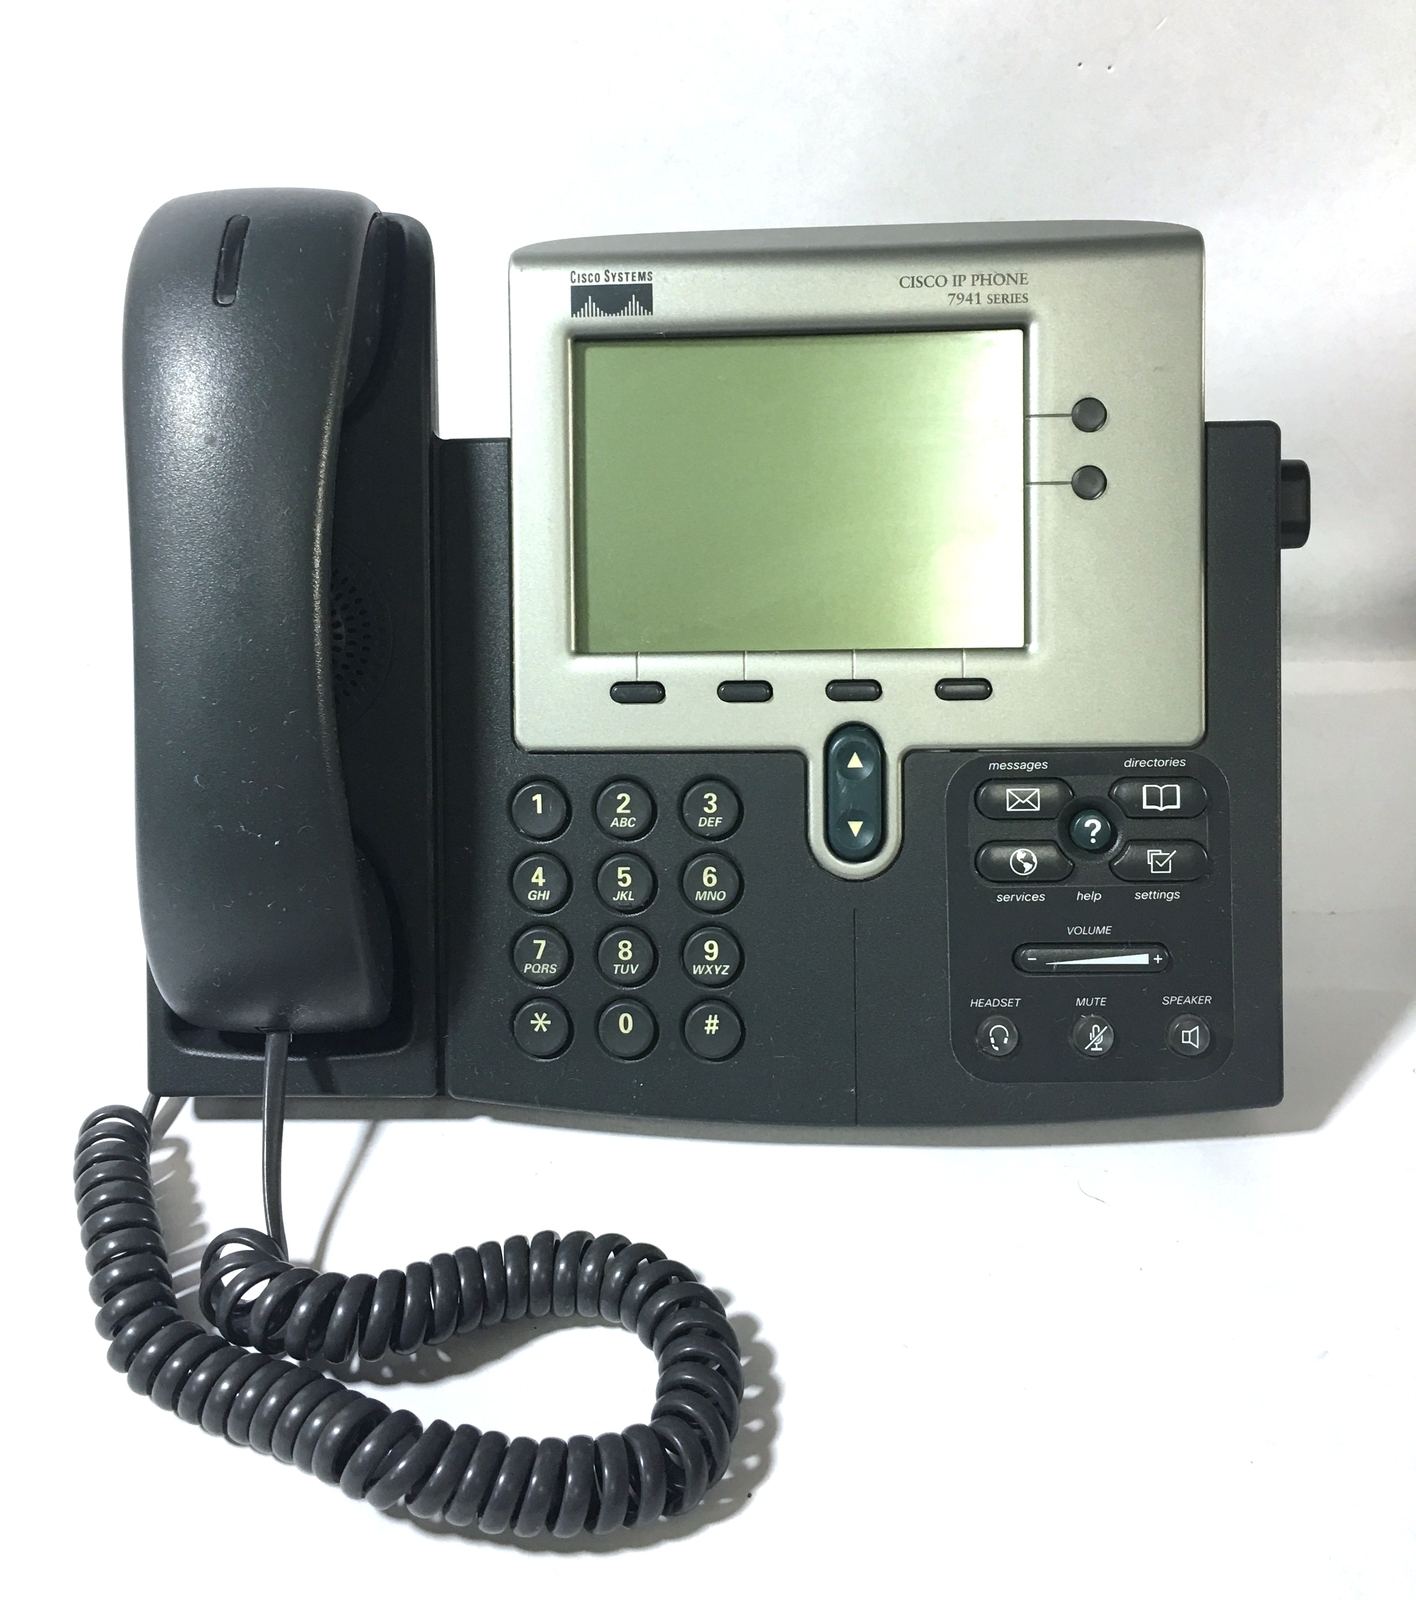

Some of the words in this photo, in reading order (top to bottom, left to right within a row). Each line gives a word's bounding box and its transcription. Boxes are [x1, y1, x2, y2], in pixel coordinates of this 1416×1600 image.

[898, 274, 949, 289] CISCO
[951, 274, 967, 287] IP
[970, 271, 1029, 287] PHONE
[947, 291, 982, 306] 7941
[986, 292, 1029, 305] SERIES
[988, 760, 1049, 772] messages
[1123, 756, 1187, 768] directories
[531, 793, 543, 815] 1
[616, 792, 631, 814] 2
[703, 792, 718, 814] 3
[609, 816, 637, 828] ABC
[697, 816, 723, 828] DEF
[530, 866, 546, 887] 4
[617, 866, 632, 888] 5
[702, 866, 718, 888] 6
[527, 889, 551, 901] GHI
[612, 890, 635, 901] JKL
[694, 890, 727, 902] MNO
[996, 891, 1046, 903] services
[1076, 890, 1102, 903] help
[1134, 890, 1181, 901] settings
[1066, 925, 1113, 936] VOLUME
[532, 939, 547, 960] 7
[617, 939, 633, 961] 8
[703, 939, 719, 962] 9
[523, 963, 558, 974] PQRS
[614, 963, 640, 975] TUV
[692, 964, 730, 976] WXYZ
[969, 997, 1022, 1008] HEADSET
[1075, 996, 1107, 1007] MUTE
[1161, 995, 1213, 1006] SPEAKER
[618, 1012, 634, 1034] 0
[703, 1014, 720, 1035] #
